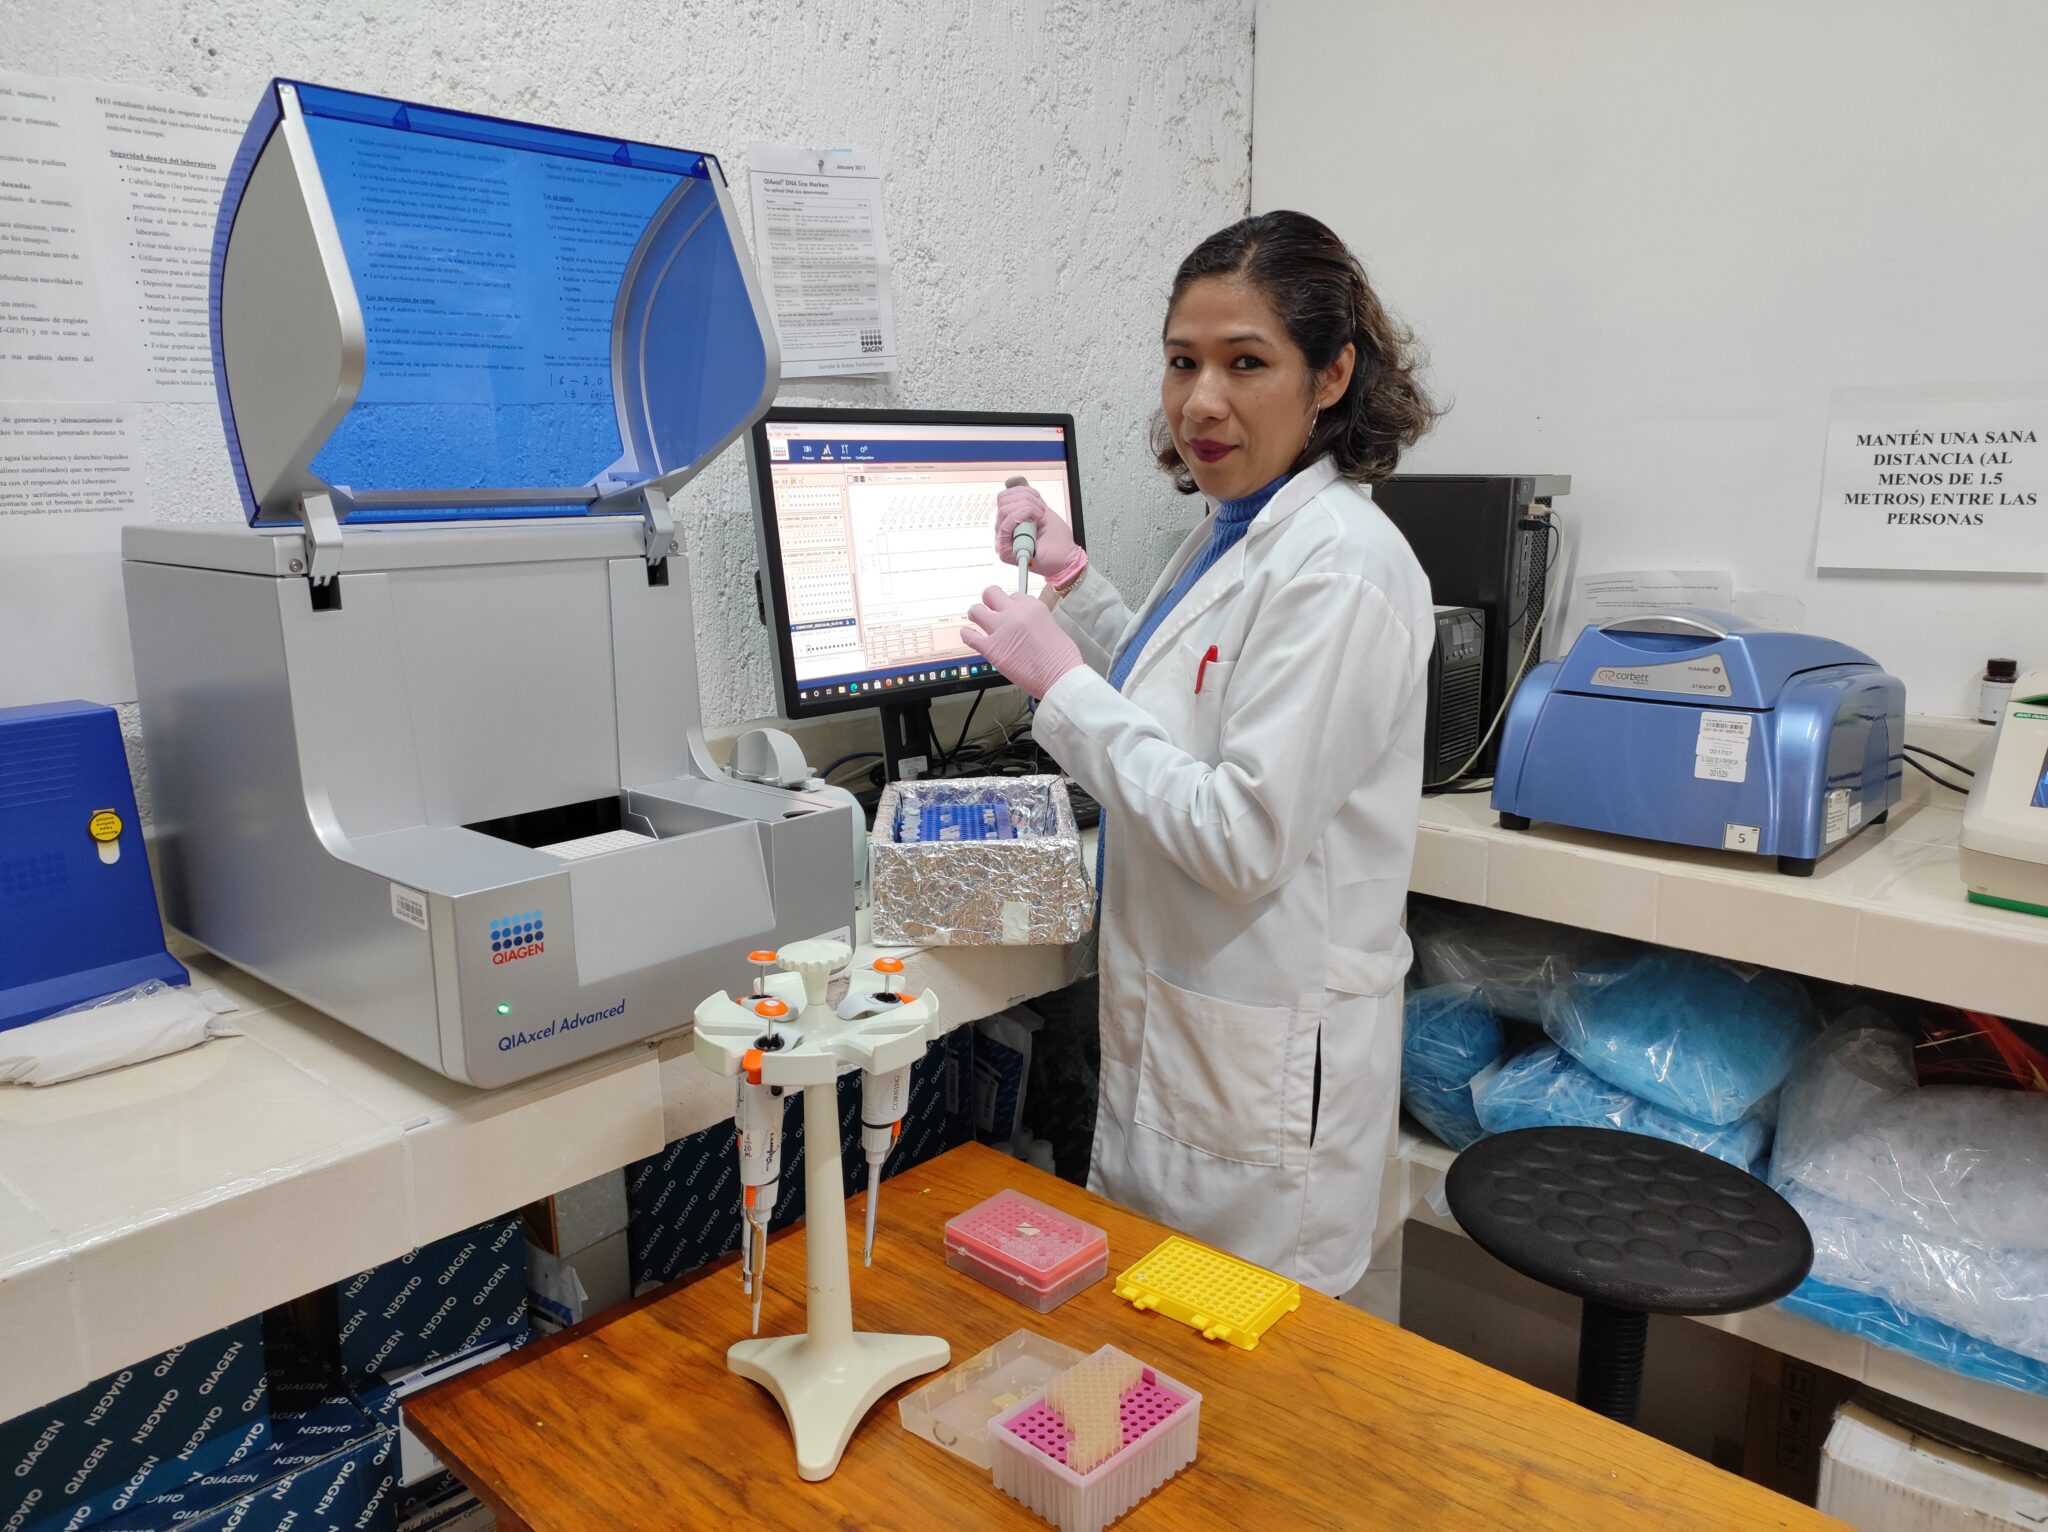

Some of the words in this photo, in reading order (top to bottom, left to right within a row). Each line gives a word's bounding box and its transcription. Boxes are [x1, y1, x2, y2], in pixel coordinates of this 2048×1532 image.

[110, 149, 144, 161] Seguridad
[180, 158, 217, 170] laboratorio
[1856, 430, 1935, 447] MANTÉN
[1940, 432, 1979, 445] UNA
[1984, 430, 2037, 444] SANA
[1873, 452, 1974, 466] DISTANCIA
[1980, 452, 2013, 467] (AL
[1878, 472, 1944, 486] MENOS
[1948, 472, 1974, 485] DE
[1980, 472, 2003, 485] 1.5
[1844, 493, 1925, 508] METROS)
[1930, 493, 1994, 506] ENTRE
[1999, 493, 2037, 506] LAS
[1887, 513, 1984, 526] PERSONAS
[1616, 671, 1648, 682] corbett
[1738, 833, 1746, 844] 5
[492, 942, 545, 965] QIAGEN
[498, 1020, 555, 1051] QIAxcel
[560, 999, 626, 1033] Advanced
[921, 1091, 941, 1121] QIAGEN
[662, 1136, 689, 1172] QIAGEN
[912, 1128, 932, 1158] QIAGEN
[685, 1151, 711, 1187] QIAGEN
[707, 1165, 733, 1201] QIAGEN
[650, 1179, 676, 1216] QIAGEN
[673, 1194, 699, 1230] QIAGEN
[775, 1186, 797, 1220] QIAGEN
[638, 1223, 665, 1261] QIAGEN
[695, 1208, 720, 1245] QIAGEN
[437, 1242, 477, 1286] QIAGEN
[662, 1237, 688, 1275] QIAGEN
[382, 1275, 422, 1320] QIAGEN
[472, 1263, 511, 1306] QIAGEN
[418, 1296, 458, 1340] QIAGEN
[199, 1341, 244, 1395] QIAGEN
[364, 1329, 405, 1374] QIAGEN
[84, 1370, 133, 1427] QIAGEN
[131, 1388, 179, 1445] QIAGEN
[177, 1406, 223, 1461] QIAGEN
[225, 1422, 265, 1467] QIAGE
[297, 1424, 352, 1434] QIAGEN
[14, 1419, 66, 1477] QIAGEN
[64, 1437, 114, 1495] QIAGEN
[112, 1455, 160, 1511] QIAGEN
[200, 1473, 260, 1486] QIAGEN
[314, 1460, 356, 1515] QIAGEN
[355, 1475, 393, 1529] QIAGEN
